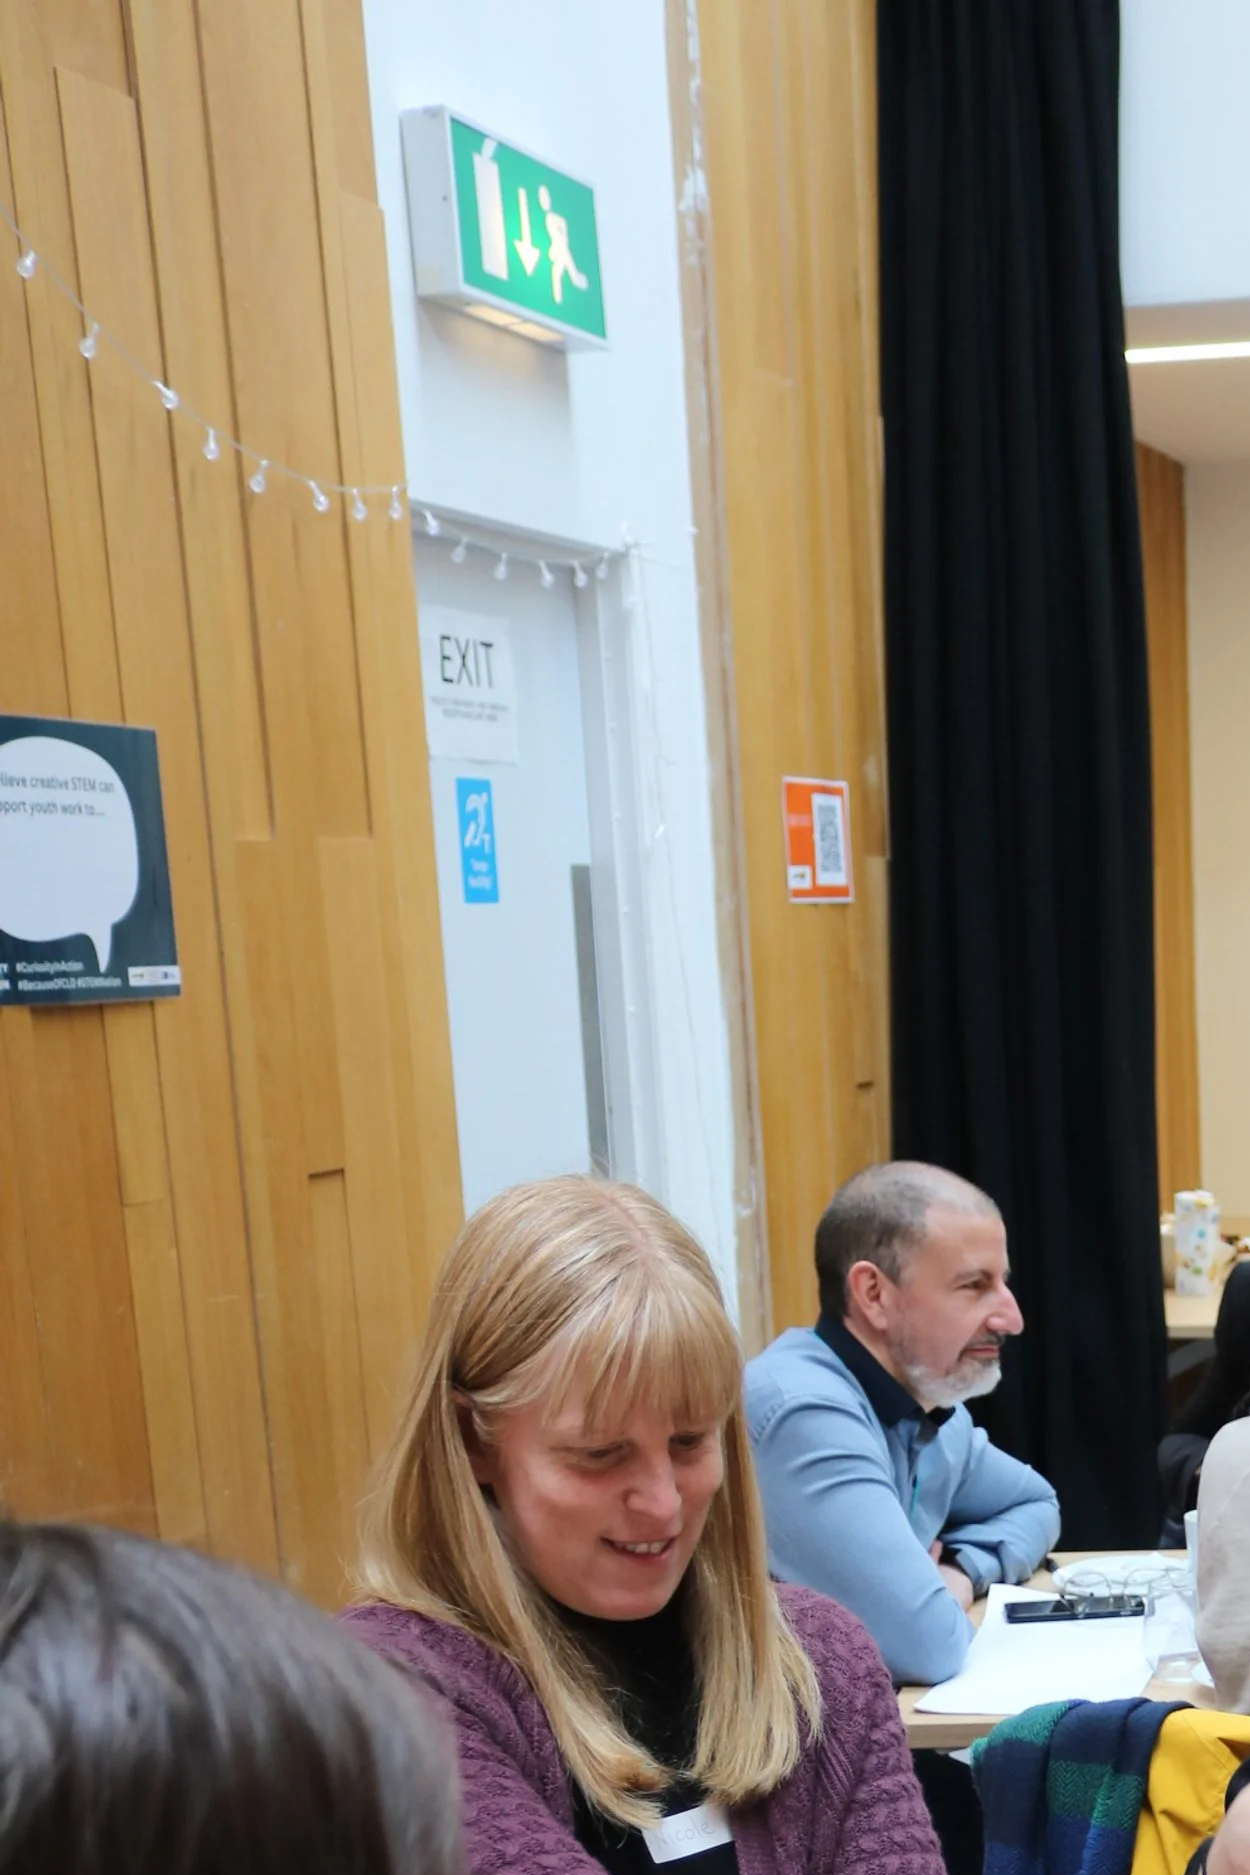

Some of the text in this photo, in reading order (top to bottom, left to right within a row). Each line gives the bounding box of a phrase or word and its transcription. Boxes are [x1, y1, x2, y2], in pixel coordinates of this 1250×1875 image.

[439, 633, 494, 688] EXIT
[30, 775, 69, 790] creative
[71, 777, 96, 792] STEM
[29, 799, 59, 816] youth
[61, 801, 82, 814] work
[652, 1816, 715, 1850] Nicole
